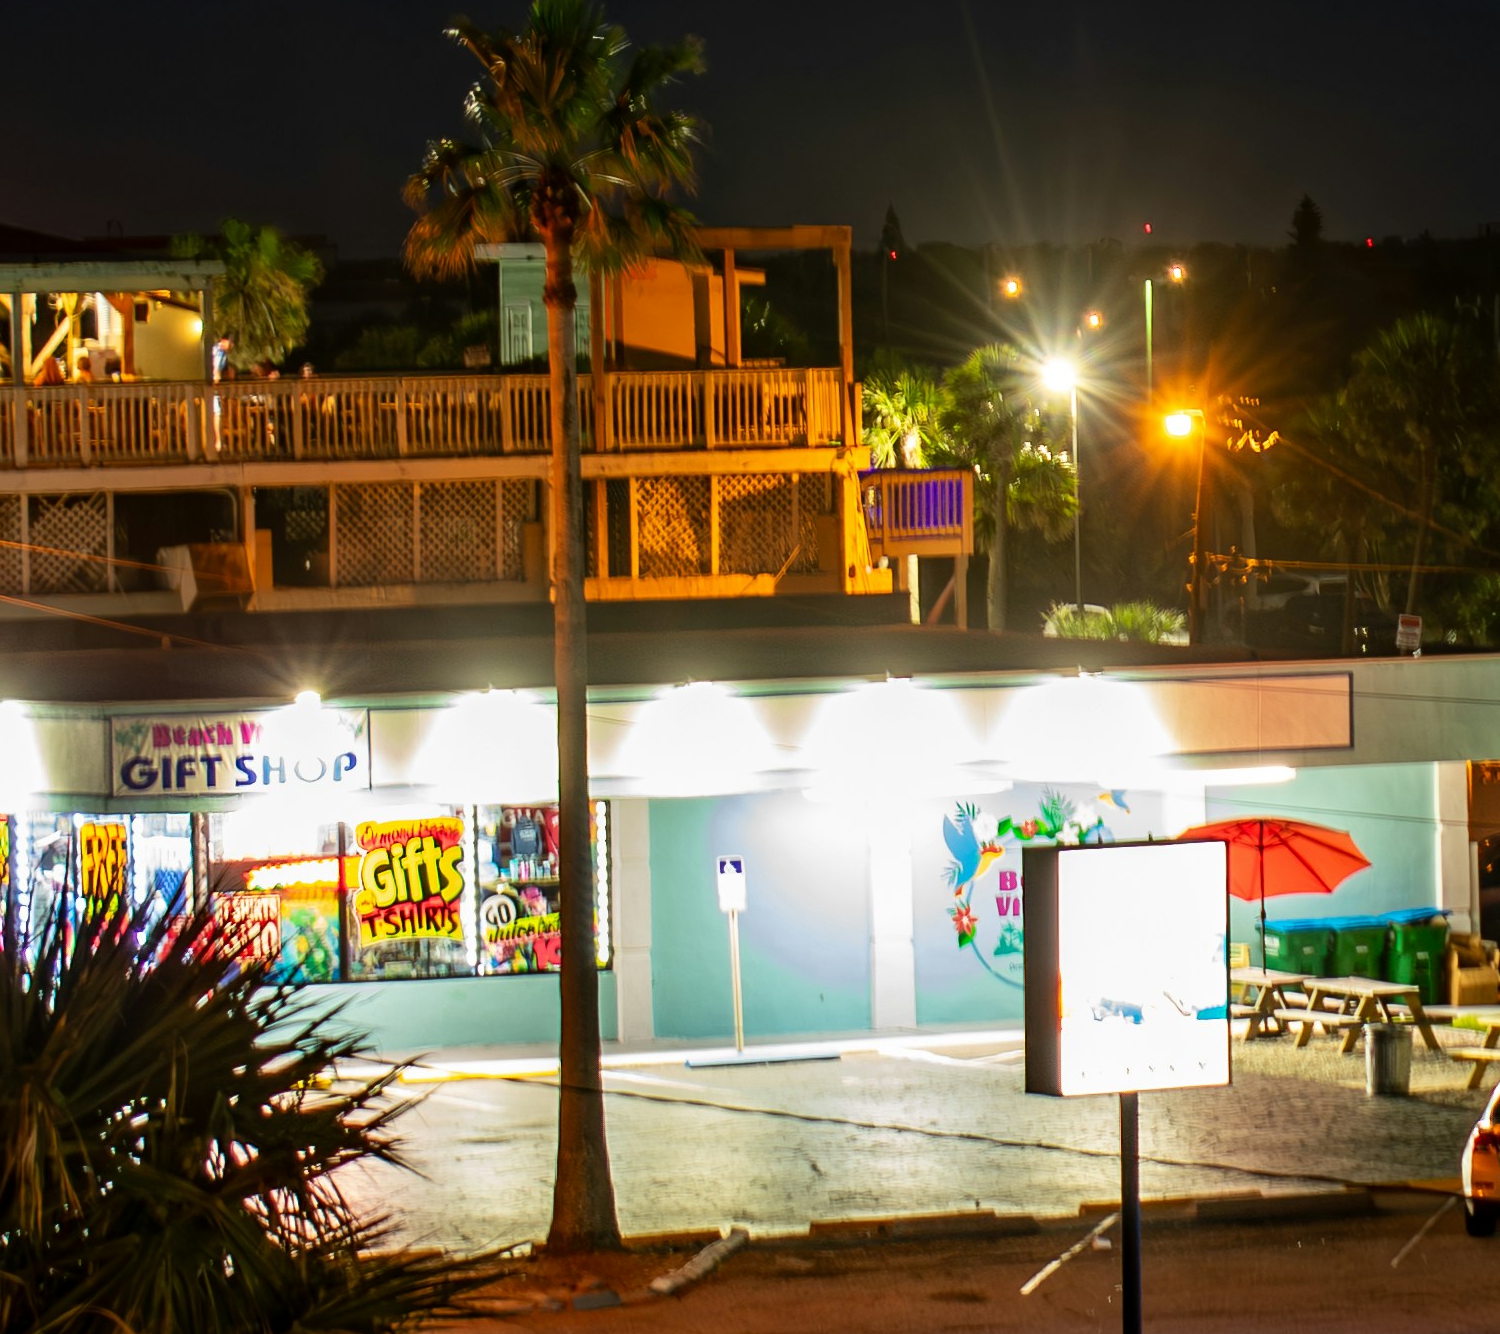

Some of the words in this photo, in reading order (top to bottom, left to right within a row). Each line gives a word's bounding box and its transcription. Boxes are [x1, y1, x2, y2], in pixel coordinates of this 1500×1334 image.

[121, 755, 222, 790] GIFT
[235, 751, 357, 787] SHOP
[362, 836, 464, 908] Gifts
